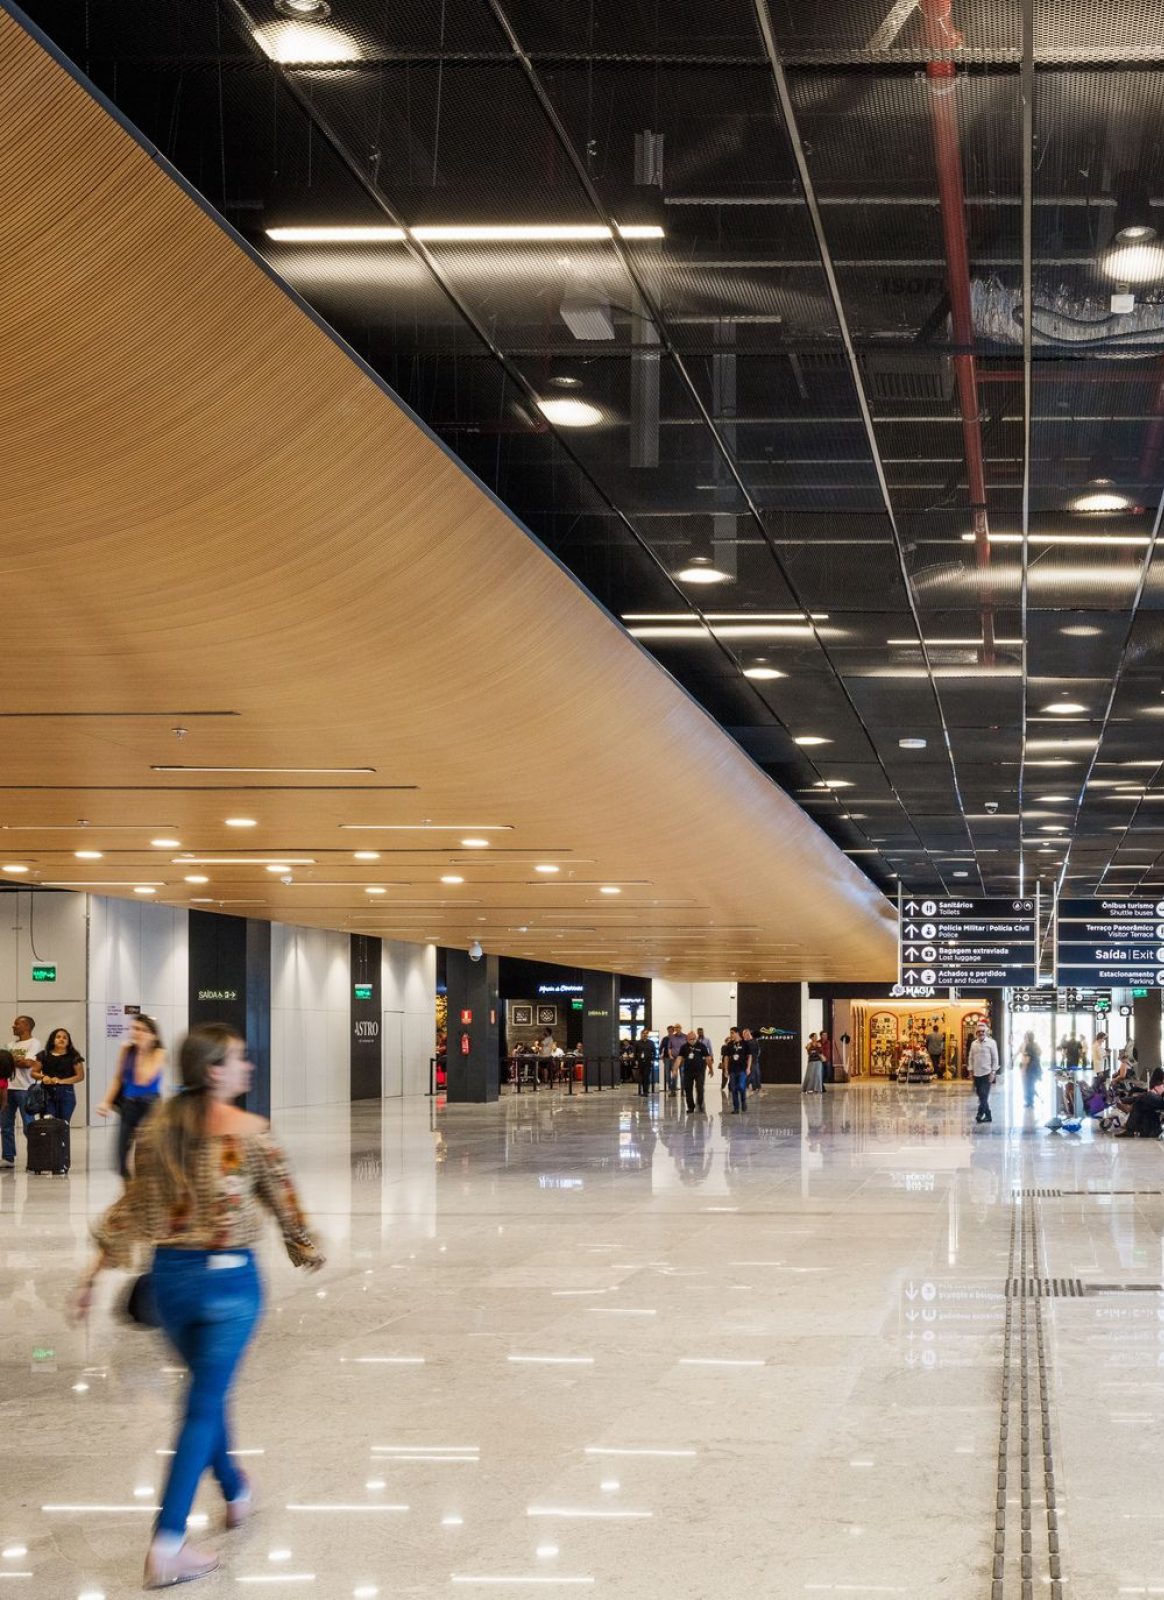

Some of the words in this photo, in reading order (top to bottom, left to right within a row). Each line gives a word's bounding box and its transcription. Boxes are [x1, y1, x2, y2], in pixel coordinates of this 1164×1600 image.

[939, 901, 973, 909] Sanitários
[1102, 901, 1126, 909] Ônibus
[1086, 924, 1112, 932] Terraço
[939, 947, 971, 956] Bagagem
[972, 947, 1009, 955] extraviada
[1095, 949, 1127, 960] Saída
[1132, 949, 1154, 960] Exit
[975, 970, 1007, 978] perdidos
[355, 1021, 379, 1036] ASTRO
